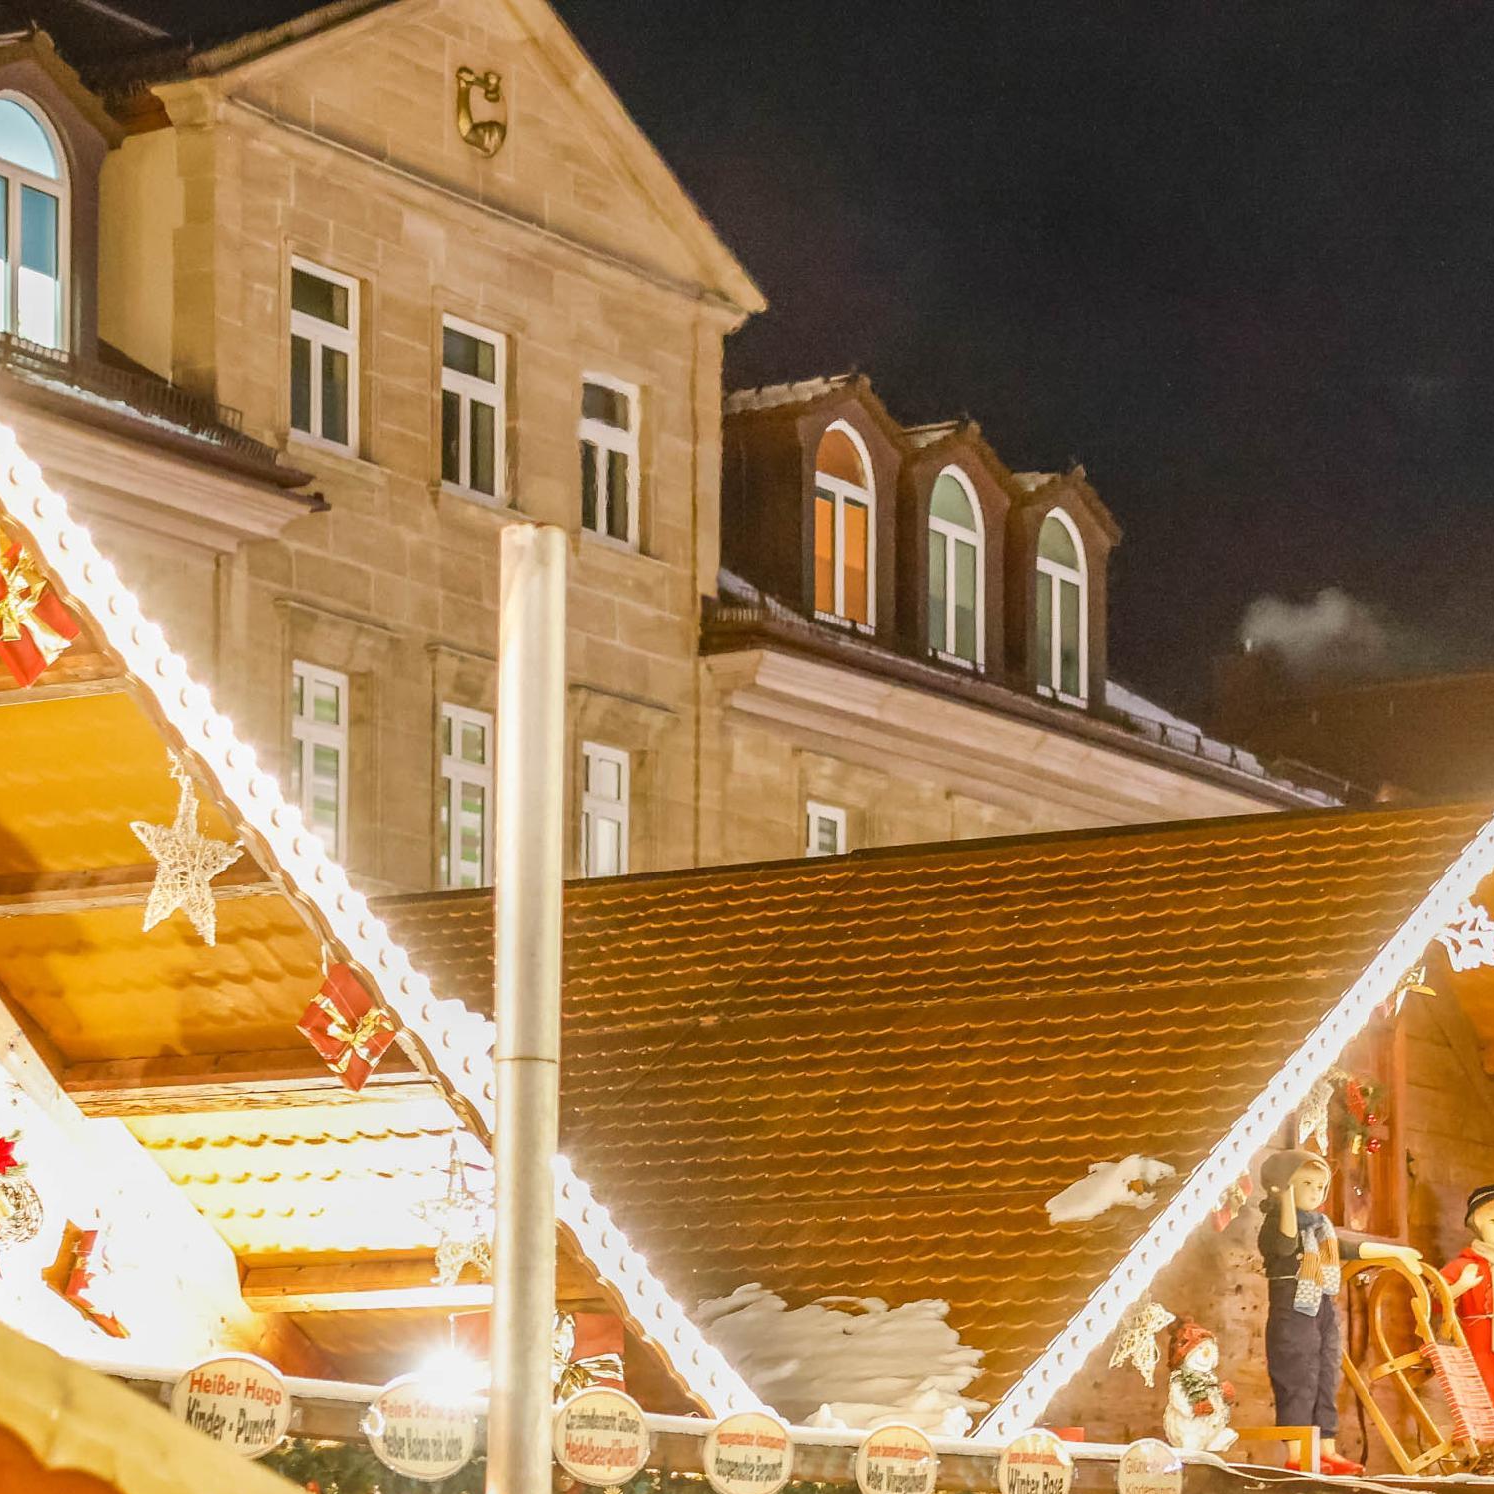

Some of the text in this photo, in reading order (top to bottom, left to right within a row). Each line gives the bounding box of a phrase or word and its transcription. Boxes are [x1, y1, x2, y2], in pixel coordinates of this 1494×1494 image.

[188, 1371, 282, 1407] Heißer Hugo
[186, 1395, 226, 1441] Kinder
